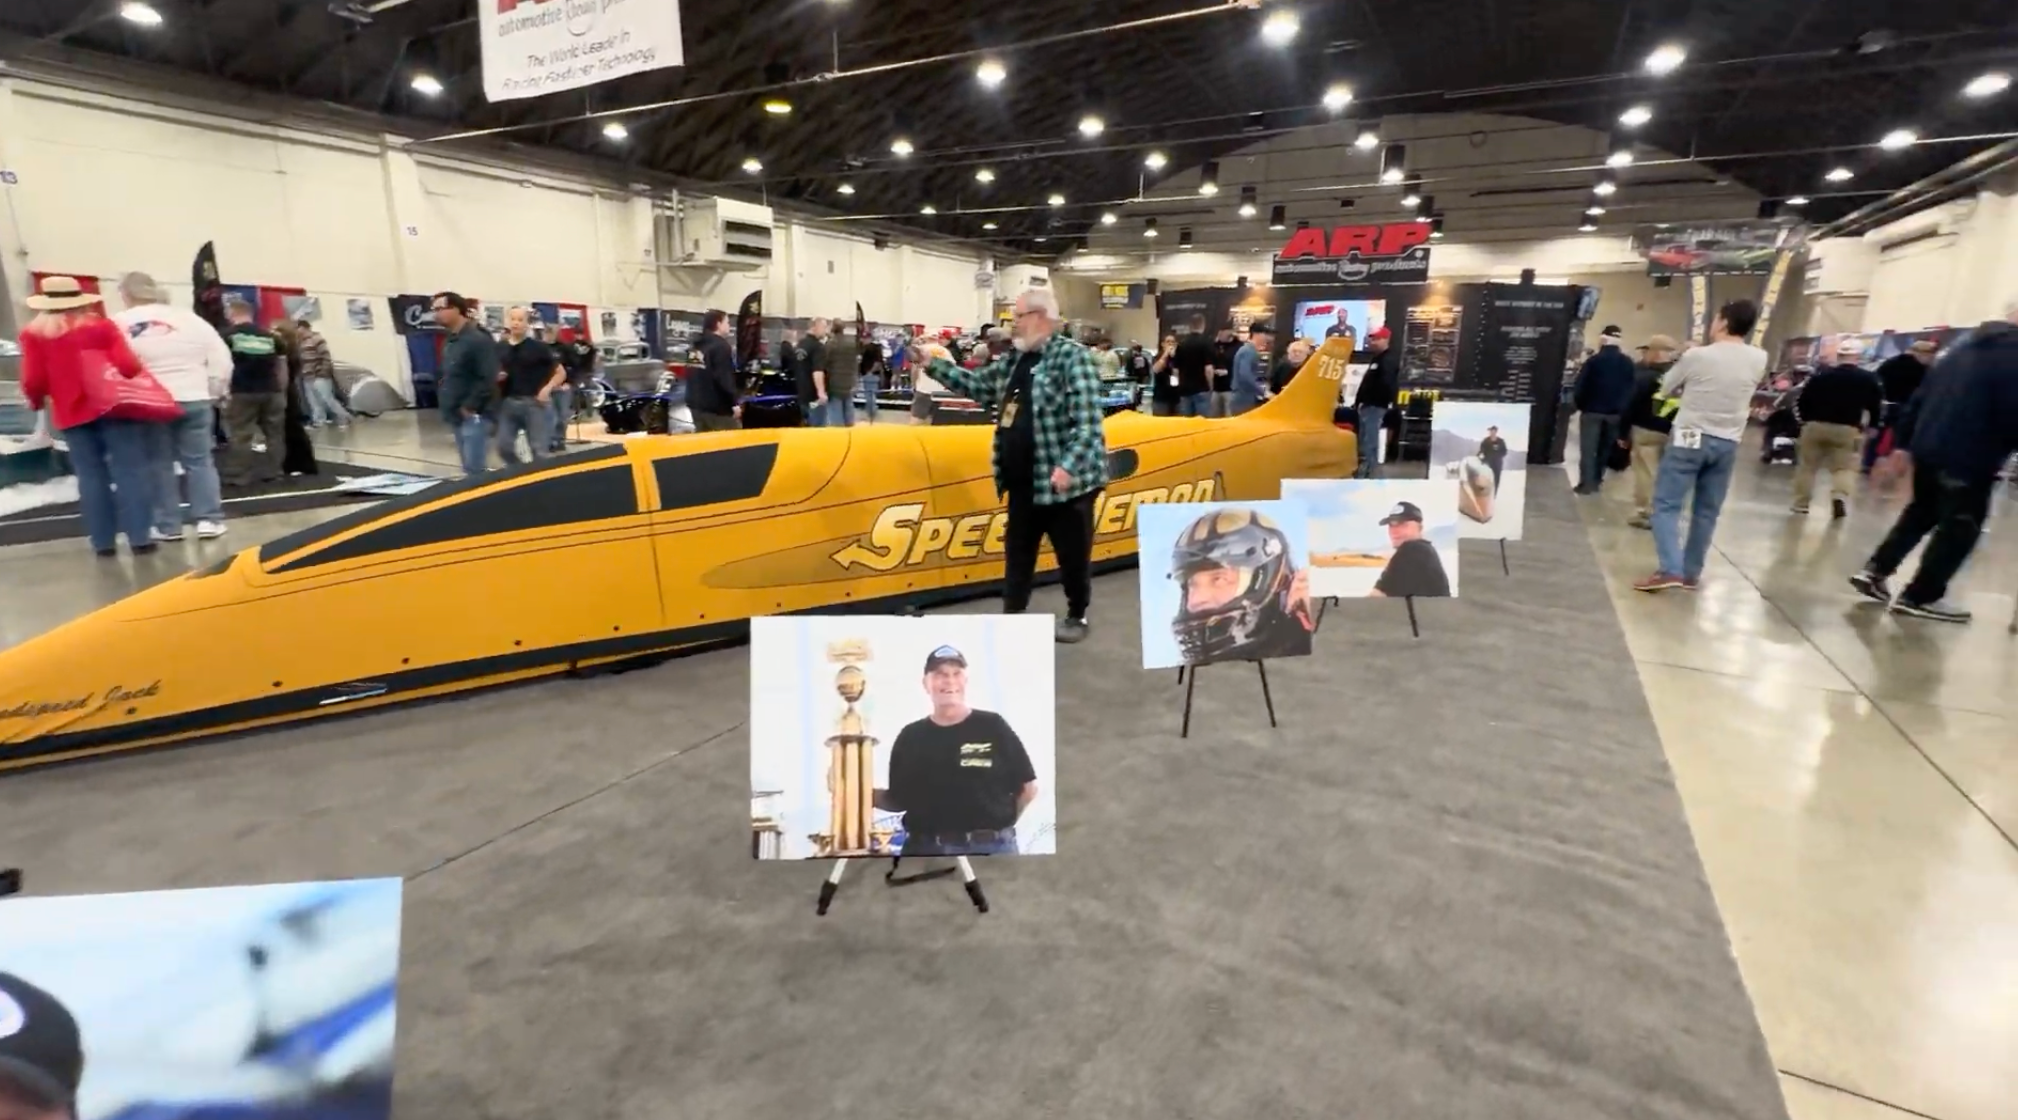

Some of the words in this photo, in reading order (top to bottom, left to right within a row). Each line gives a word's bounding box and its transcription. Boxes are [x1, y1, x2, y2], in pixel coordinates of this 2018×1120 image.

[499, 7, 563, 37] automotive
[527, 54, 547, 69] The
[1279, 222, 1433, 258] ARP
[1318, 355, 1344, 380] 715
